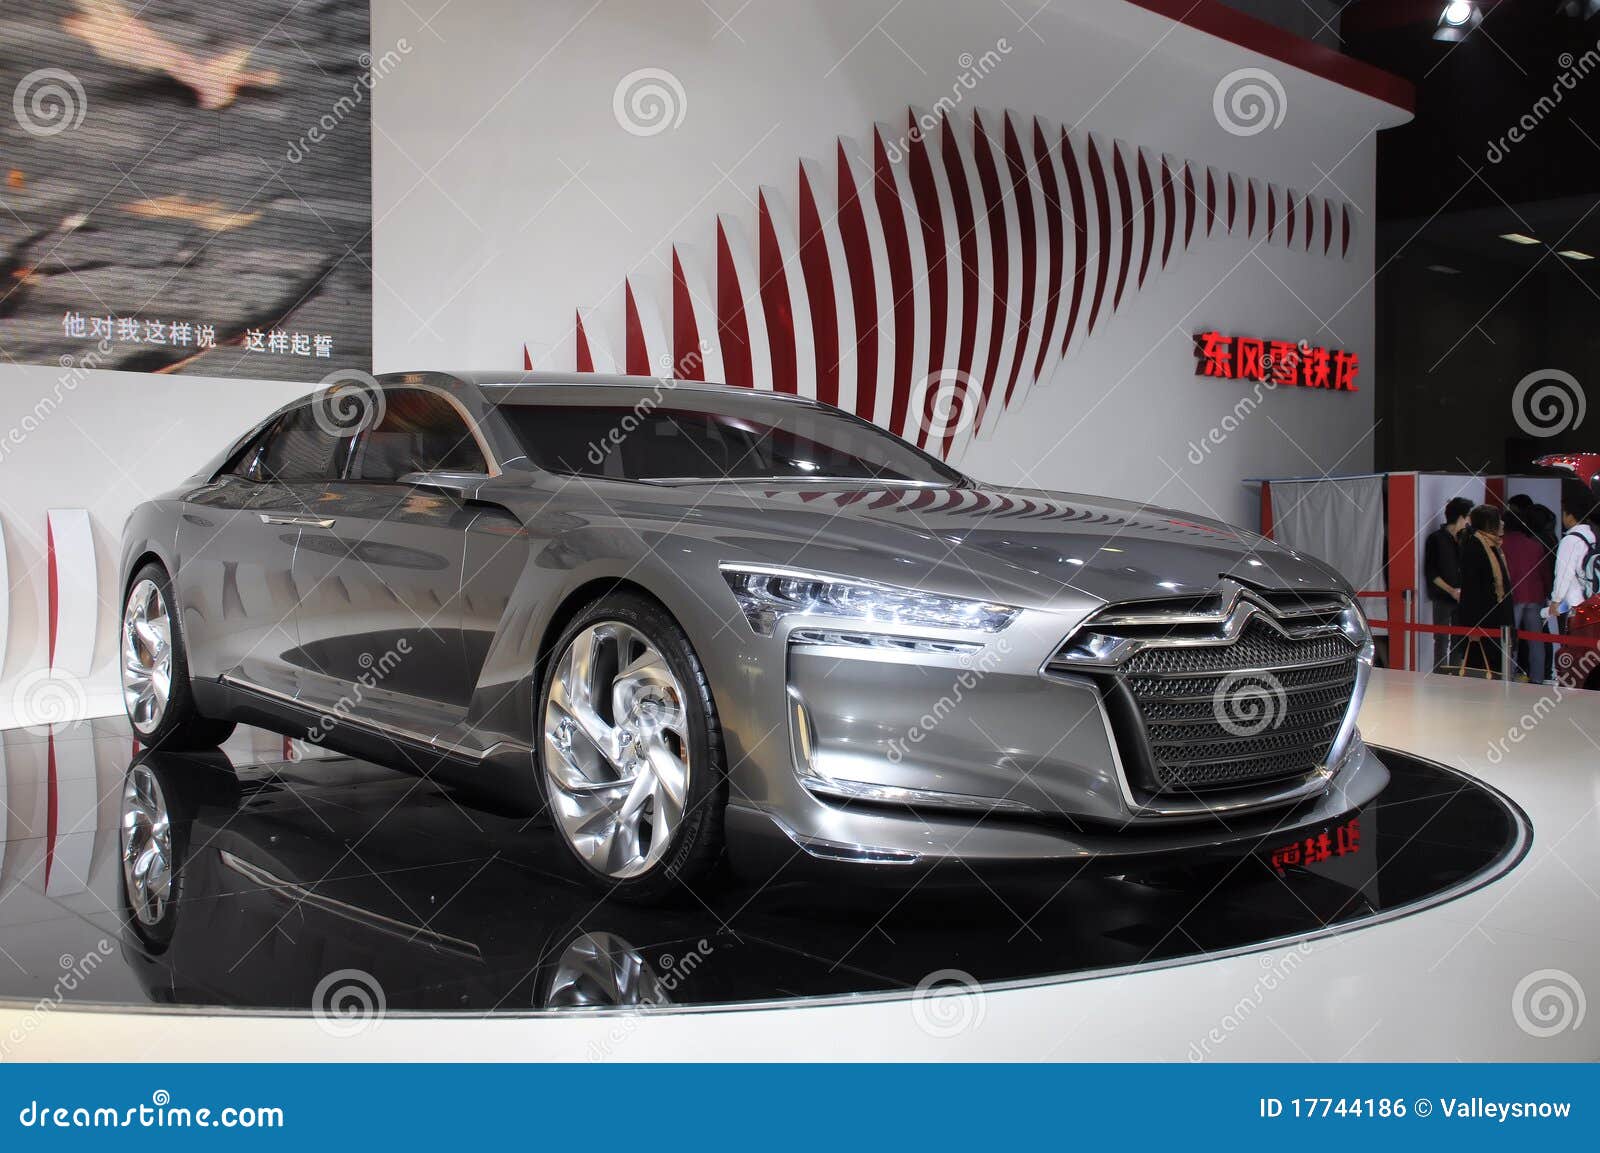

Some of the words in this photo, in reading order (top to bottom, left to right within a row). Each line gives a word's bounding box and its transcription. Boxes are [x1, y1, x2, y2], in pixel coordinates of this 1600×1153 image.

[62, 311, 217, 349] 他对我这样说
[244, 328, 333, 358] 这样起誓
[1200, 331, 1360, 392] 东风雪铁龙
